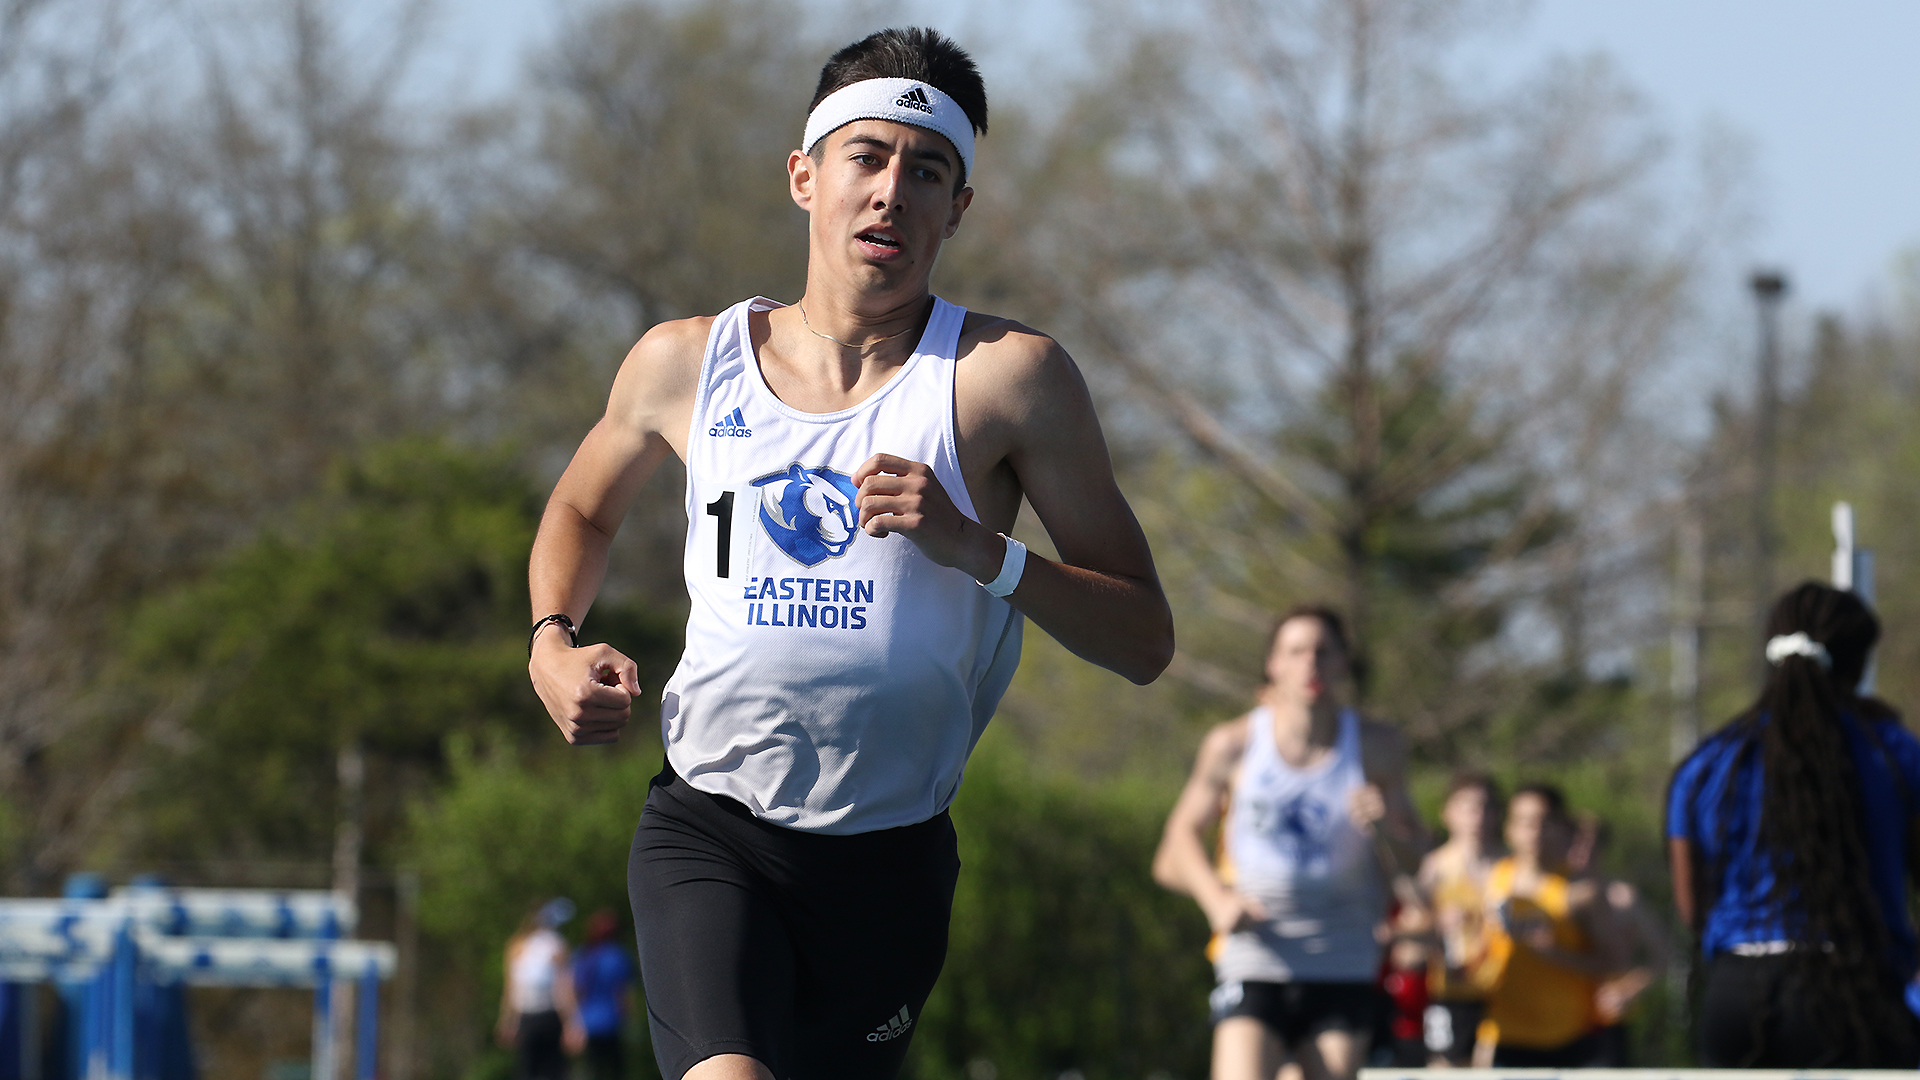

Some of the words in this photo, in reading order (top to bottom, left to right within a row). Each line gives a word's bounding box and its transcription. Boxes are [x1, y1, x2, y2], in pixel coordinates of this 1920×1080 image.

[896, 98, 933, 115] adidas
[708, 425, 752, 438] adidas
[706, 490, 735, 579] 1
[743, 576, 874, 604] EASTERN
[746, 602, 867, 630] ILLINOIS
[866, 1018, 913, 1042] adidas
